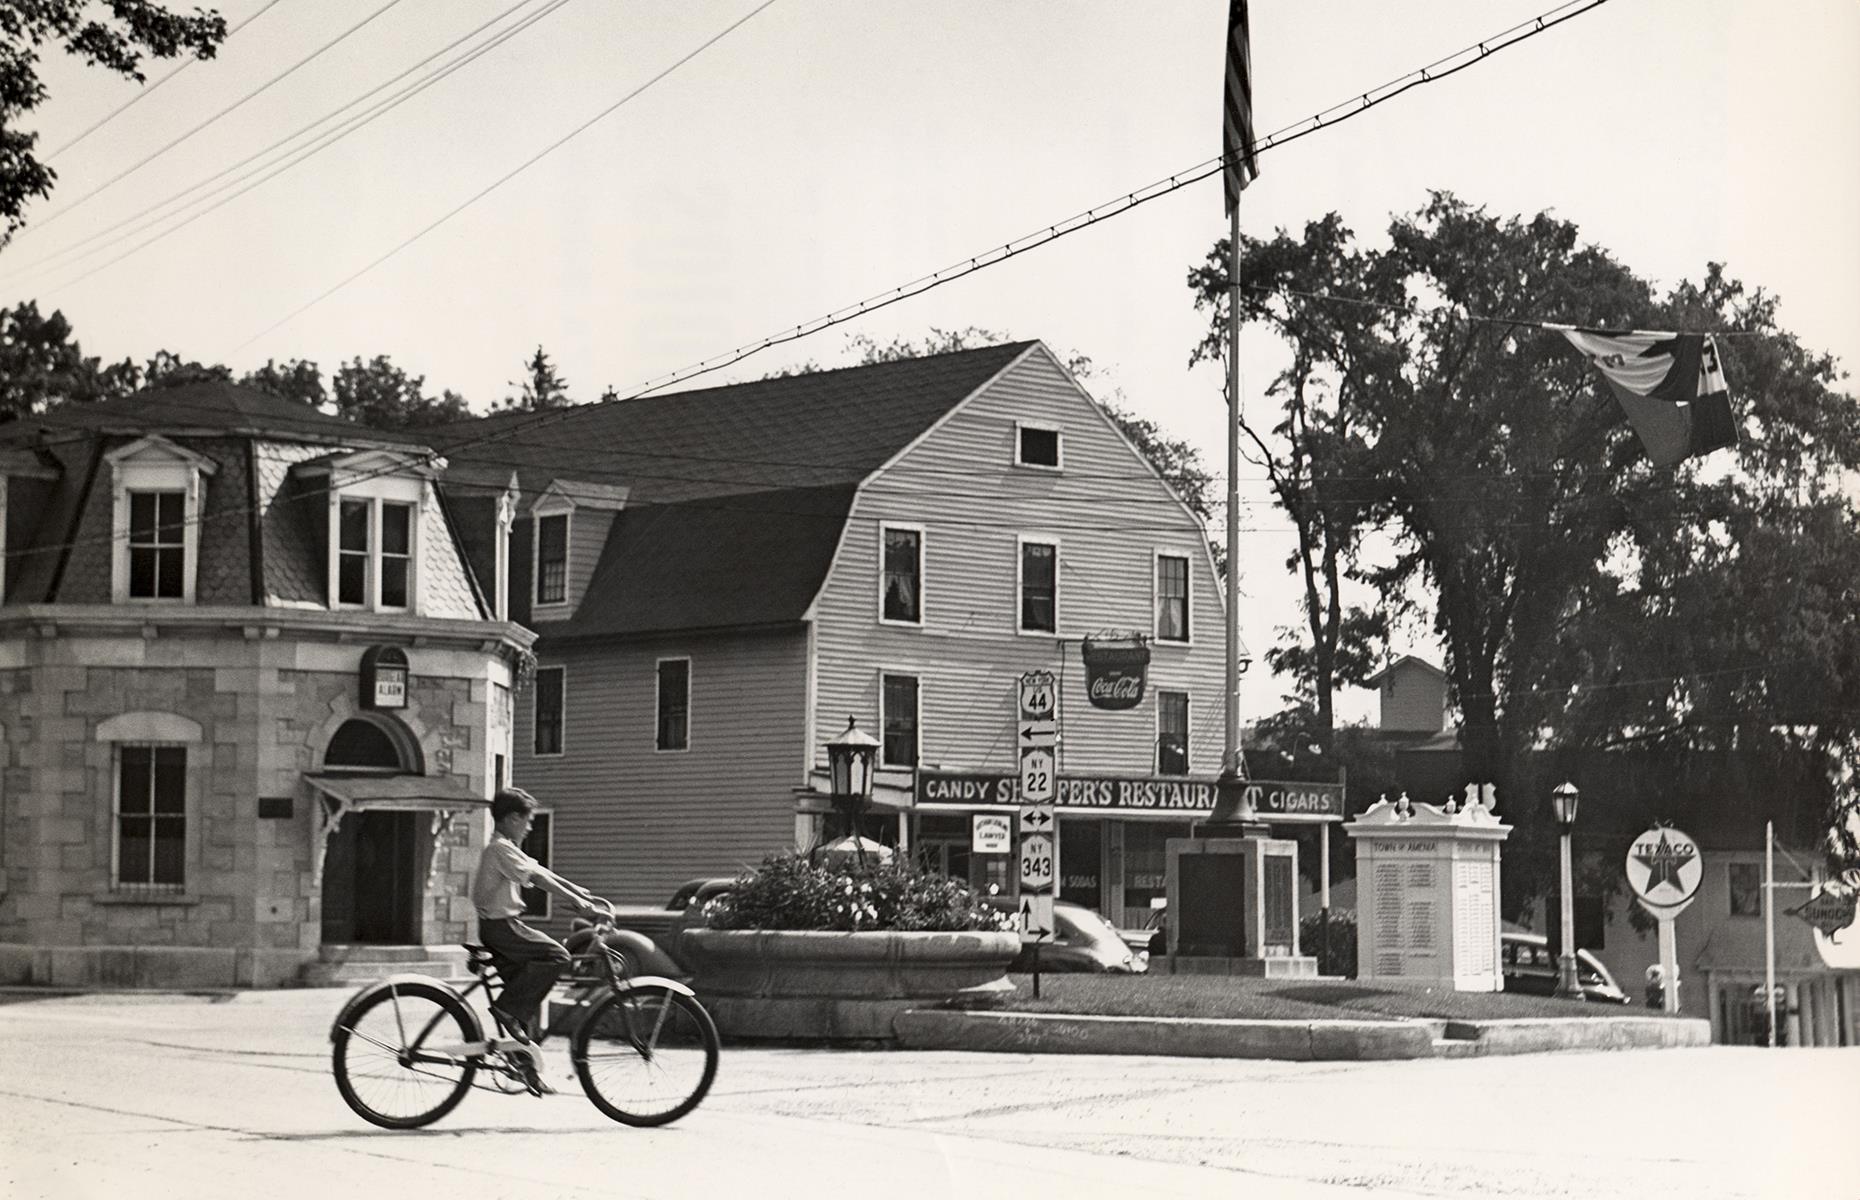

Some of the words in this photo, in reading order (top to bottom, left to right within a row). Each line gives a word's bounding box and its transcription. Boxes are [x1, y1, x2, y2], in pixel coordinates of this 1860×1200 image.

[1029, 693, 1046, 710] 44
[1031, 759, 1043, 768] NY
[1028, 772, 1046, 792] 22
[926, 780, 989, 799] CANDY
[996, 778, 1113, 806] SHFER'S
[1118, 781, 1263, 811] RESTAURT
[1269, 791, 1330, 810] CIGARS
[1031, 844, 1042, 853] NY
[1635, 843, 1694, 855] TEXACO
[1023, 857, 1051, 877] 343
